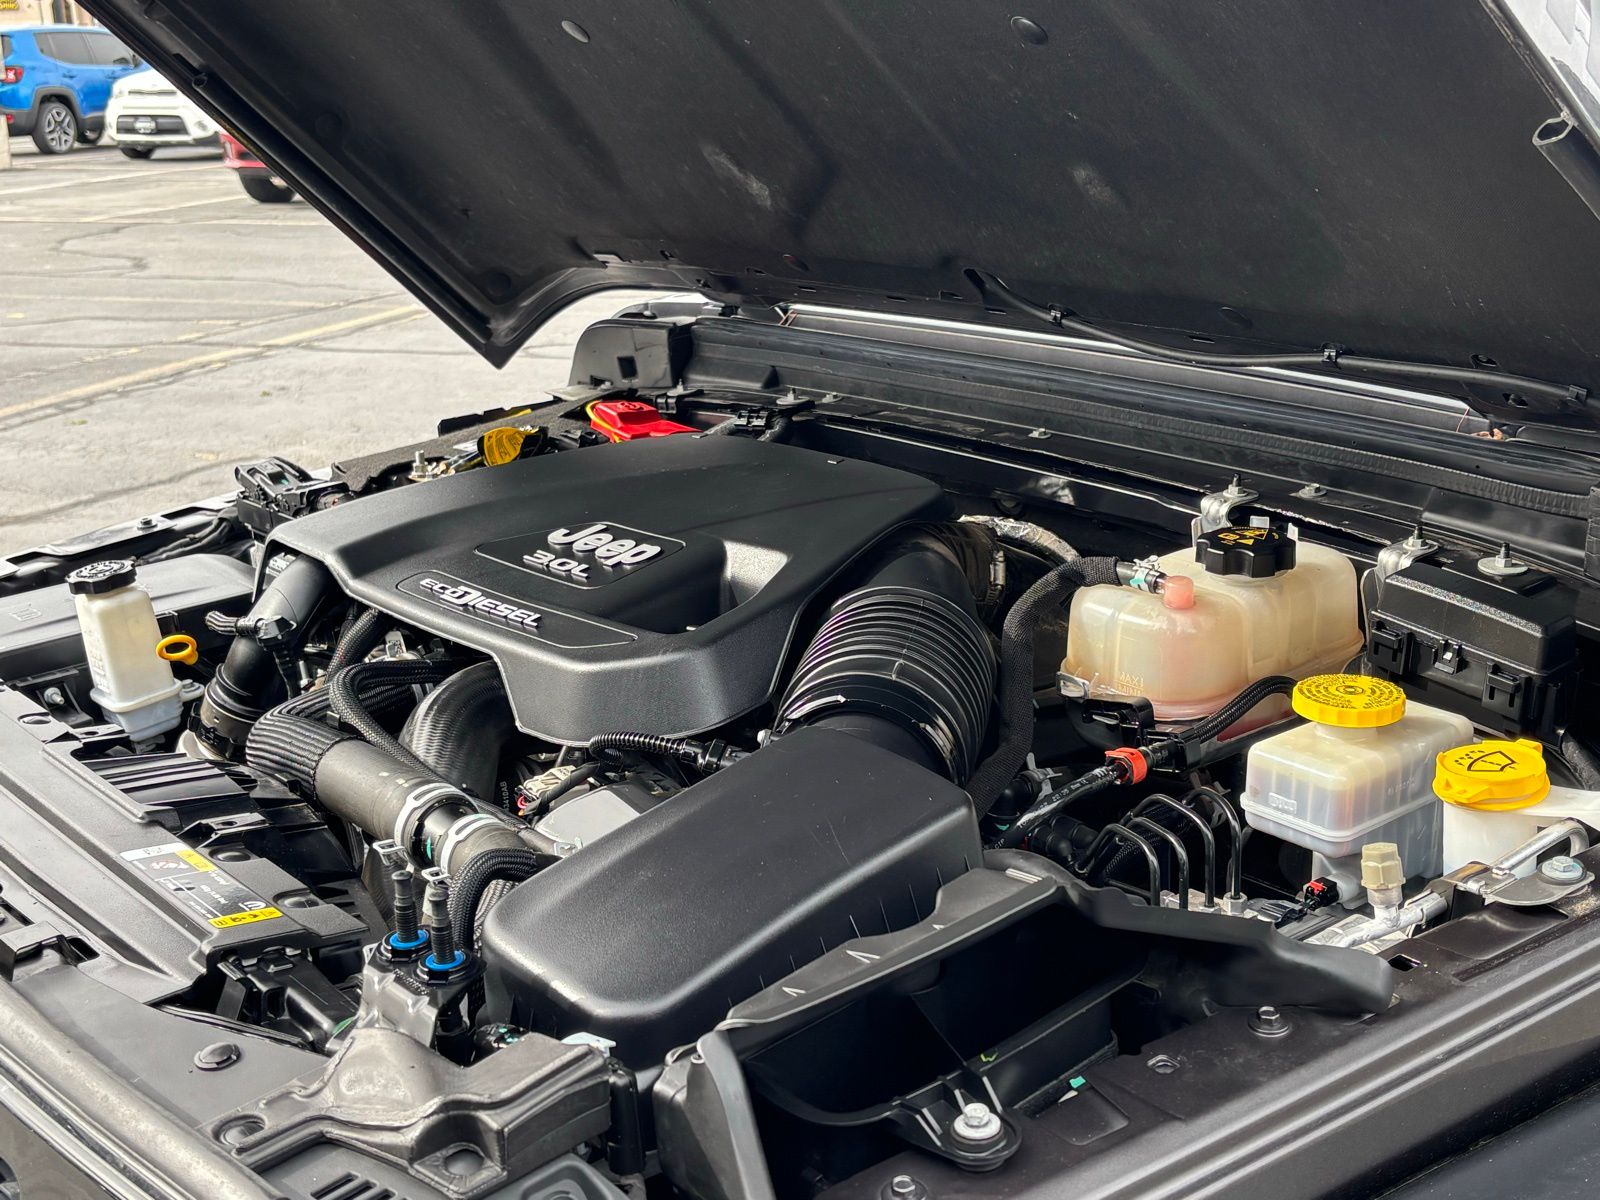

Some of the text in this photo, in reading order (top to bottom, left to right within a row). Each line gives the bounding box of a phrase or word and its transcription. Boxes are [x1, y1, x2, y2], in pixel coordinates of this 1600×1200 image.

[547, 523, 662, 567] Jeep
[523, 549, 592, 580] 3.0L
[419, 577, 544, 628] ECODIESEL
[500, 781, 510, 812] 3410AB
